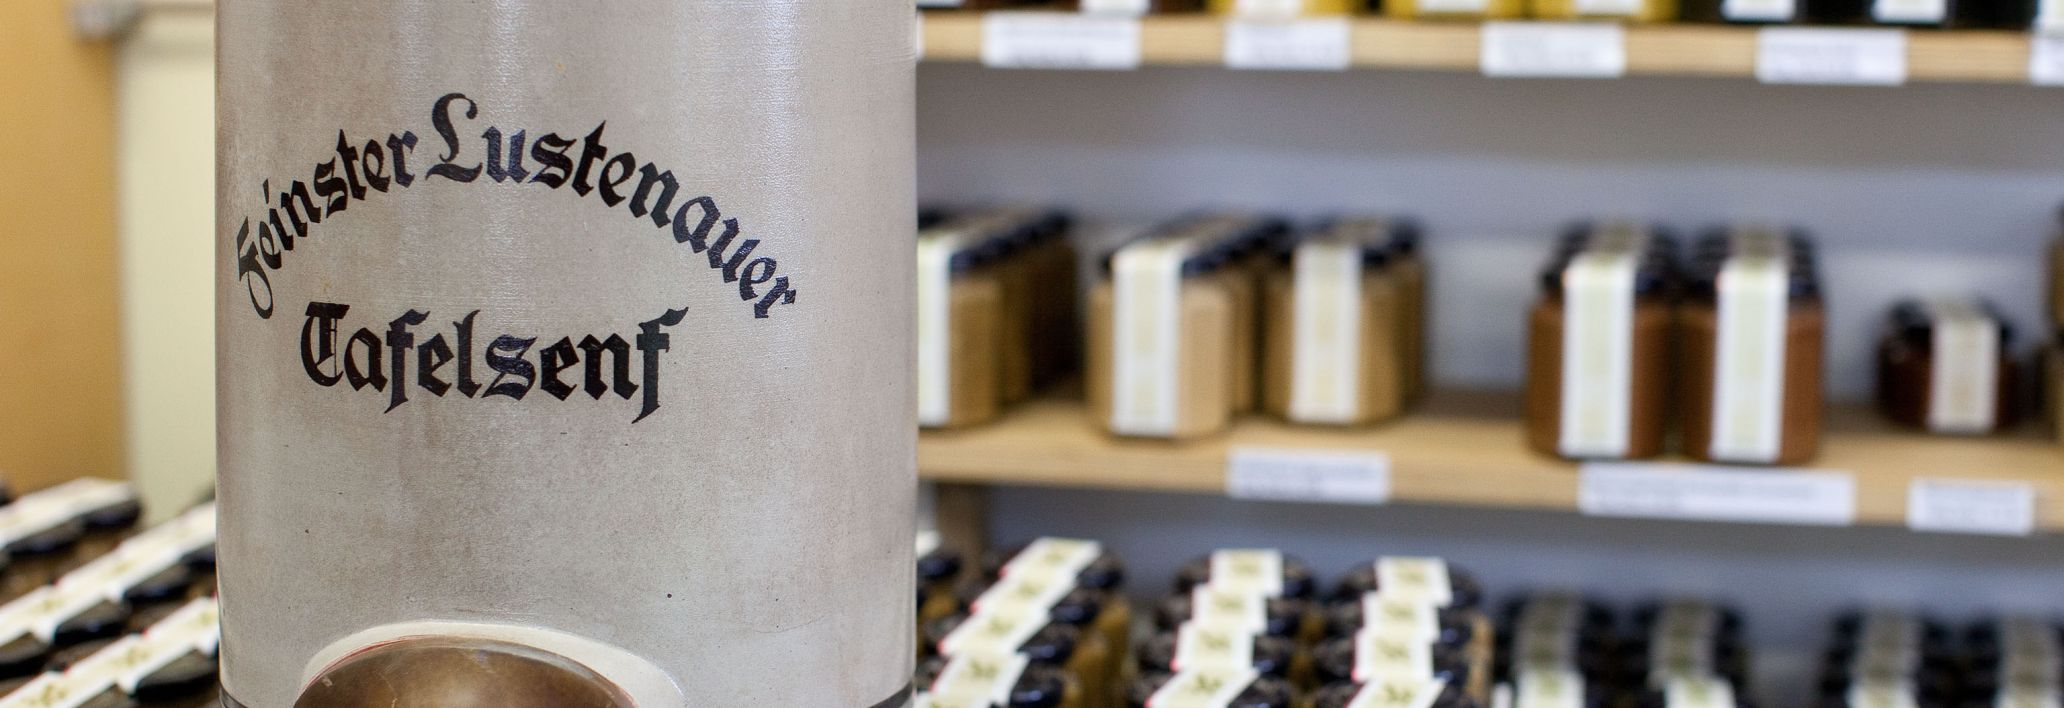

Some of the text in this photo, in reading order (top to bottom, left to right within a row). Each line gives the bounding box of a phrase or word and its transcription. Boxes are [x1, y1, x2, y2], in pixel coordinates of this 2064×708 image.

[236, 93, 796, 319] Feinster Lustenauer
[300, 301, 689, 424] Tafelsenf
